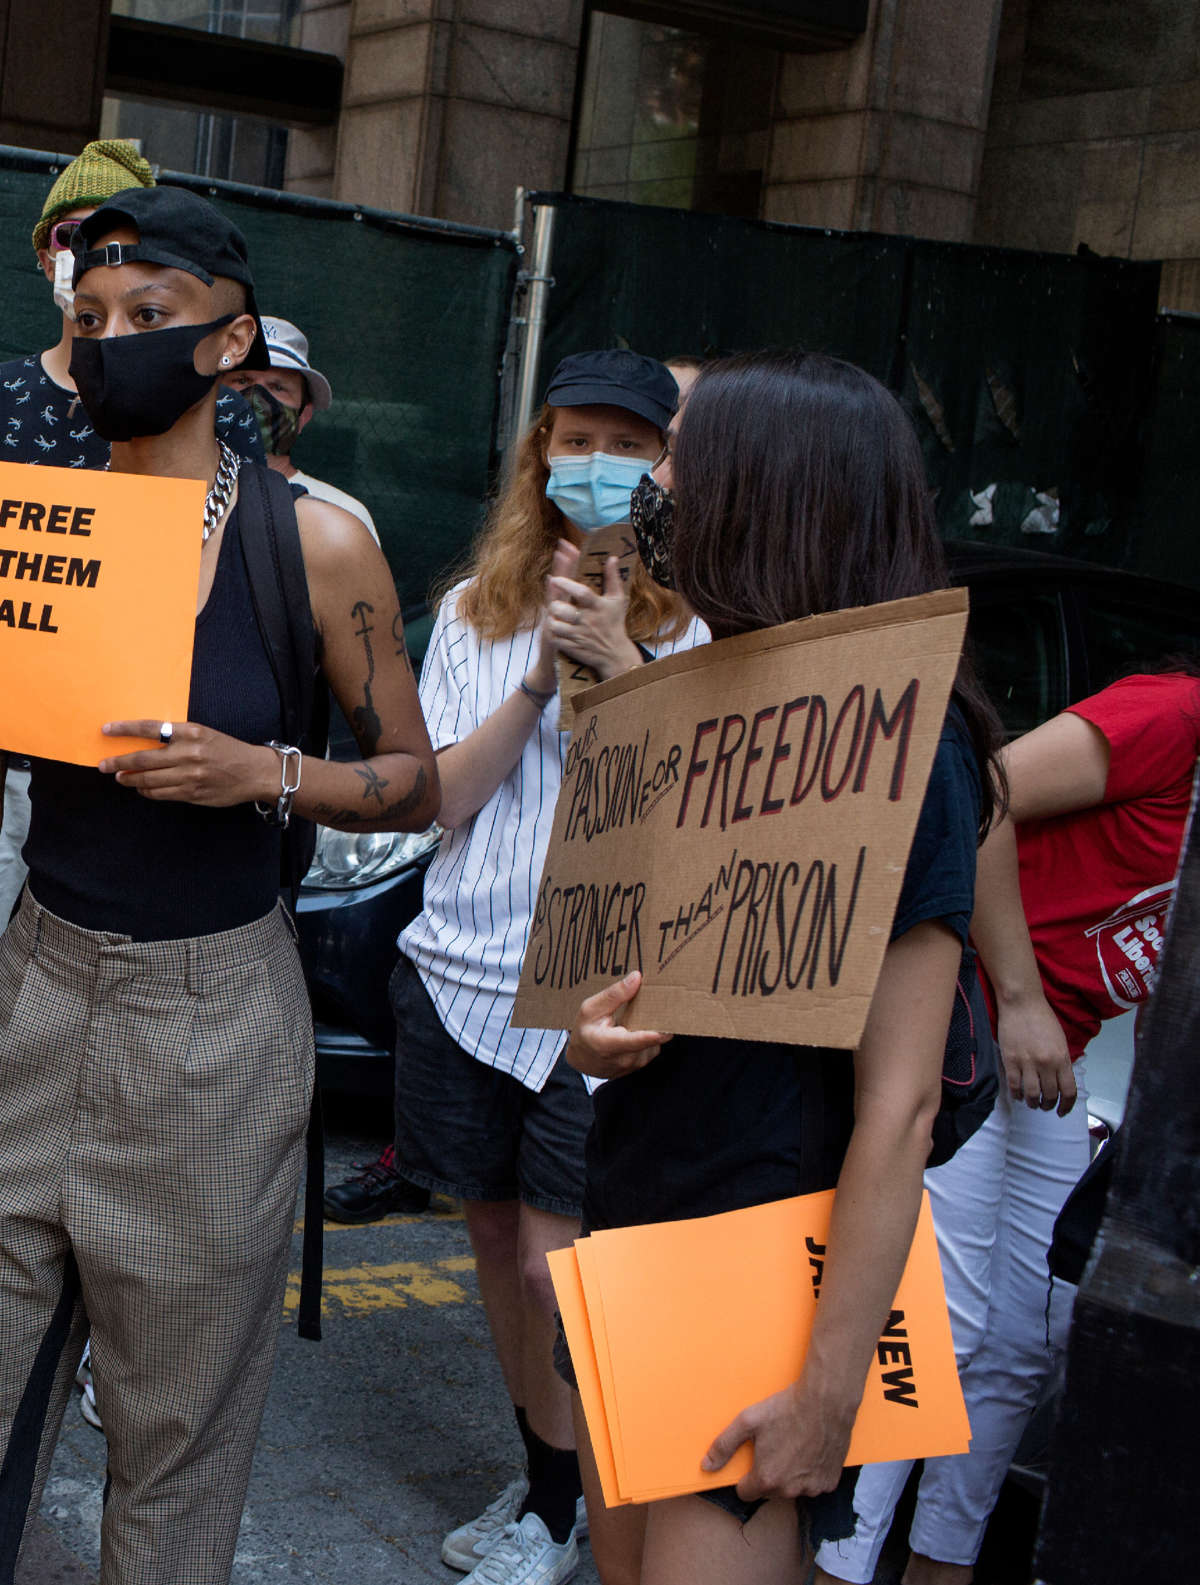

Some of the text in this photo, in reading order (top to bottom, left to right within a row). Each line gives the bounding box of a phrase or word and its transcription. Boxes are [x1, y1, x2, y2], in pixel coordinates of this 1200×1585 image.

[565, 678, 919, 842] OUR PASSION FOR FREEDOM
[534, 882, 646, 989] STRONGER
[658, 849, 737, 962] THAN
[711, 846, 866, 997] PRISON
[878, 1310, 918, 1408] NEW
